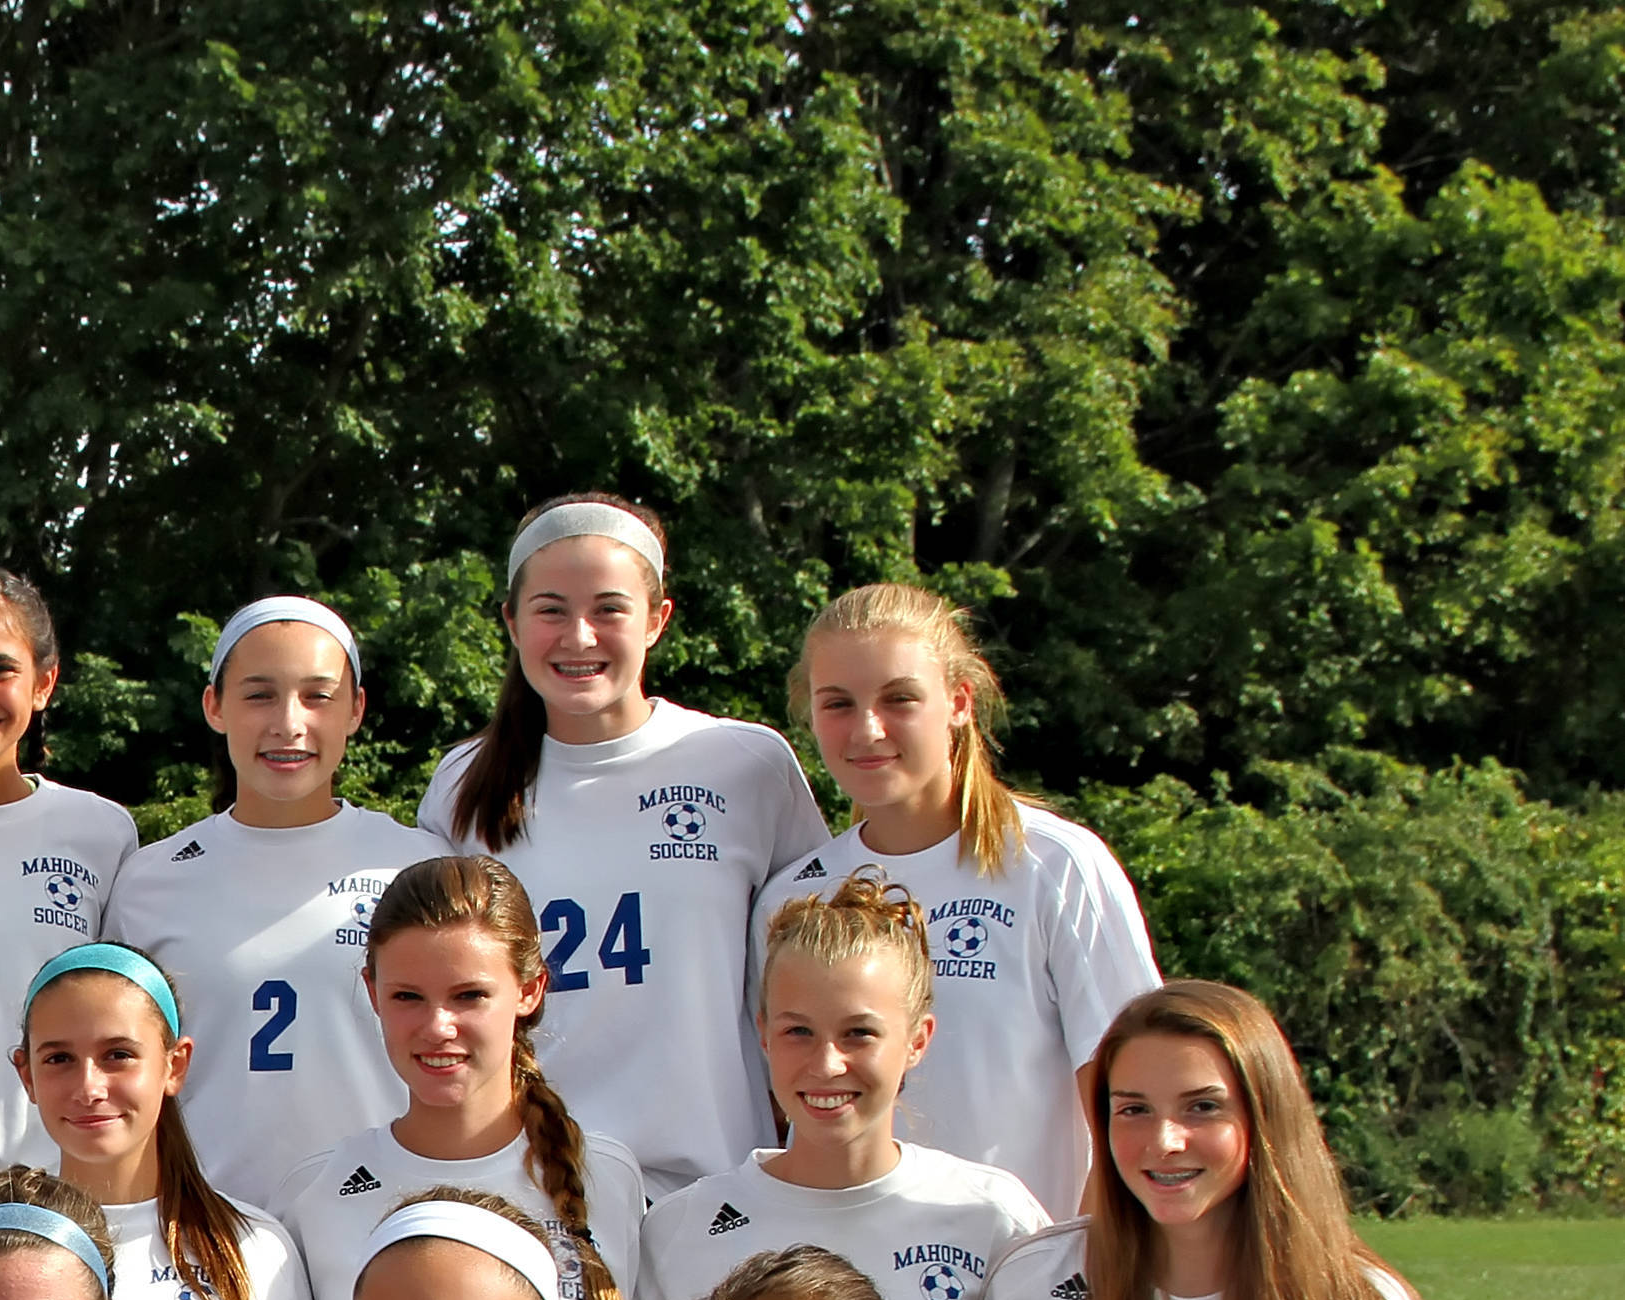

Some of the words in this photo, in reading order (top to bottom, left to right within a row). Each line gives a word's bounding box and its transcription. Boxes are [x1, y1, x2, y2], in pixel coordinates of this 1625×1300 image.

[639, 786, 726, 814] MAHOPAC
[650, 843, 719, 861] SOCCER
[328, 877, 393, 898] MAHO
[34, 907, 88, 936] SOCCER
[927, 899, 1015, 928] MAHOPAC
[335, 929, 370, 947] SOC
[540, 892, 651, 994] 24
[931, 959, 997, 980] OCCER
[249, 980, 298, 1072] 2
[338, 1180, 382, 1197] adidas
[708, 1215, 750, 1236] adidas
[893, 1244, 985, 1279] MAHOPAC
[1050, 1288, 1089, 1300] adida
